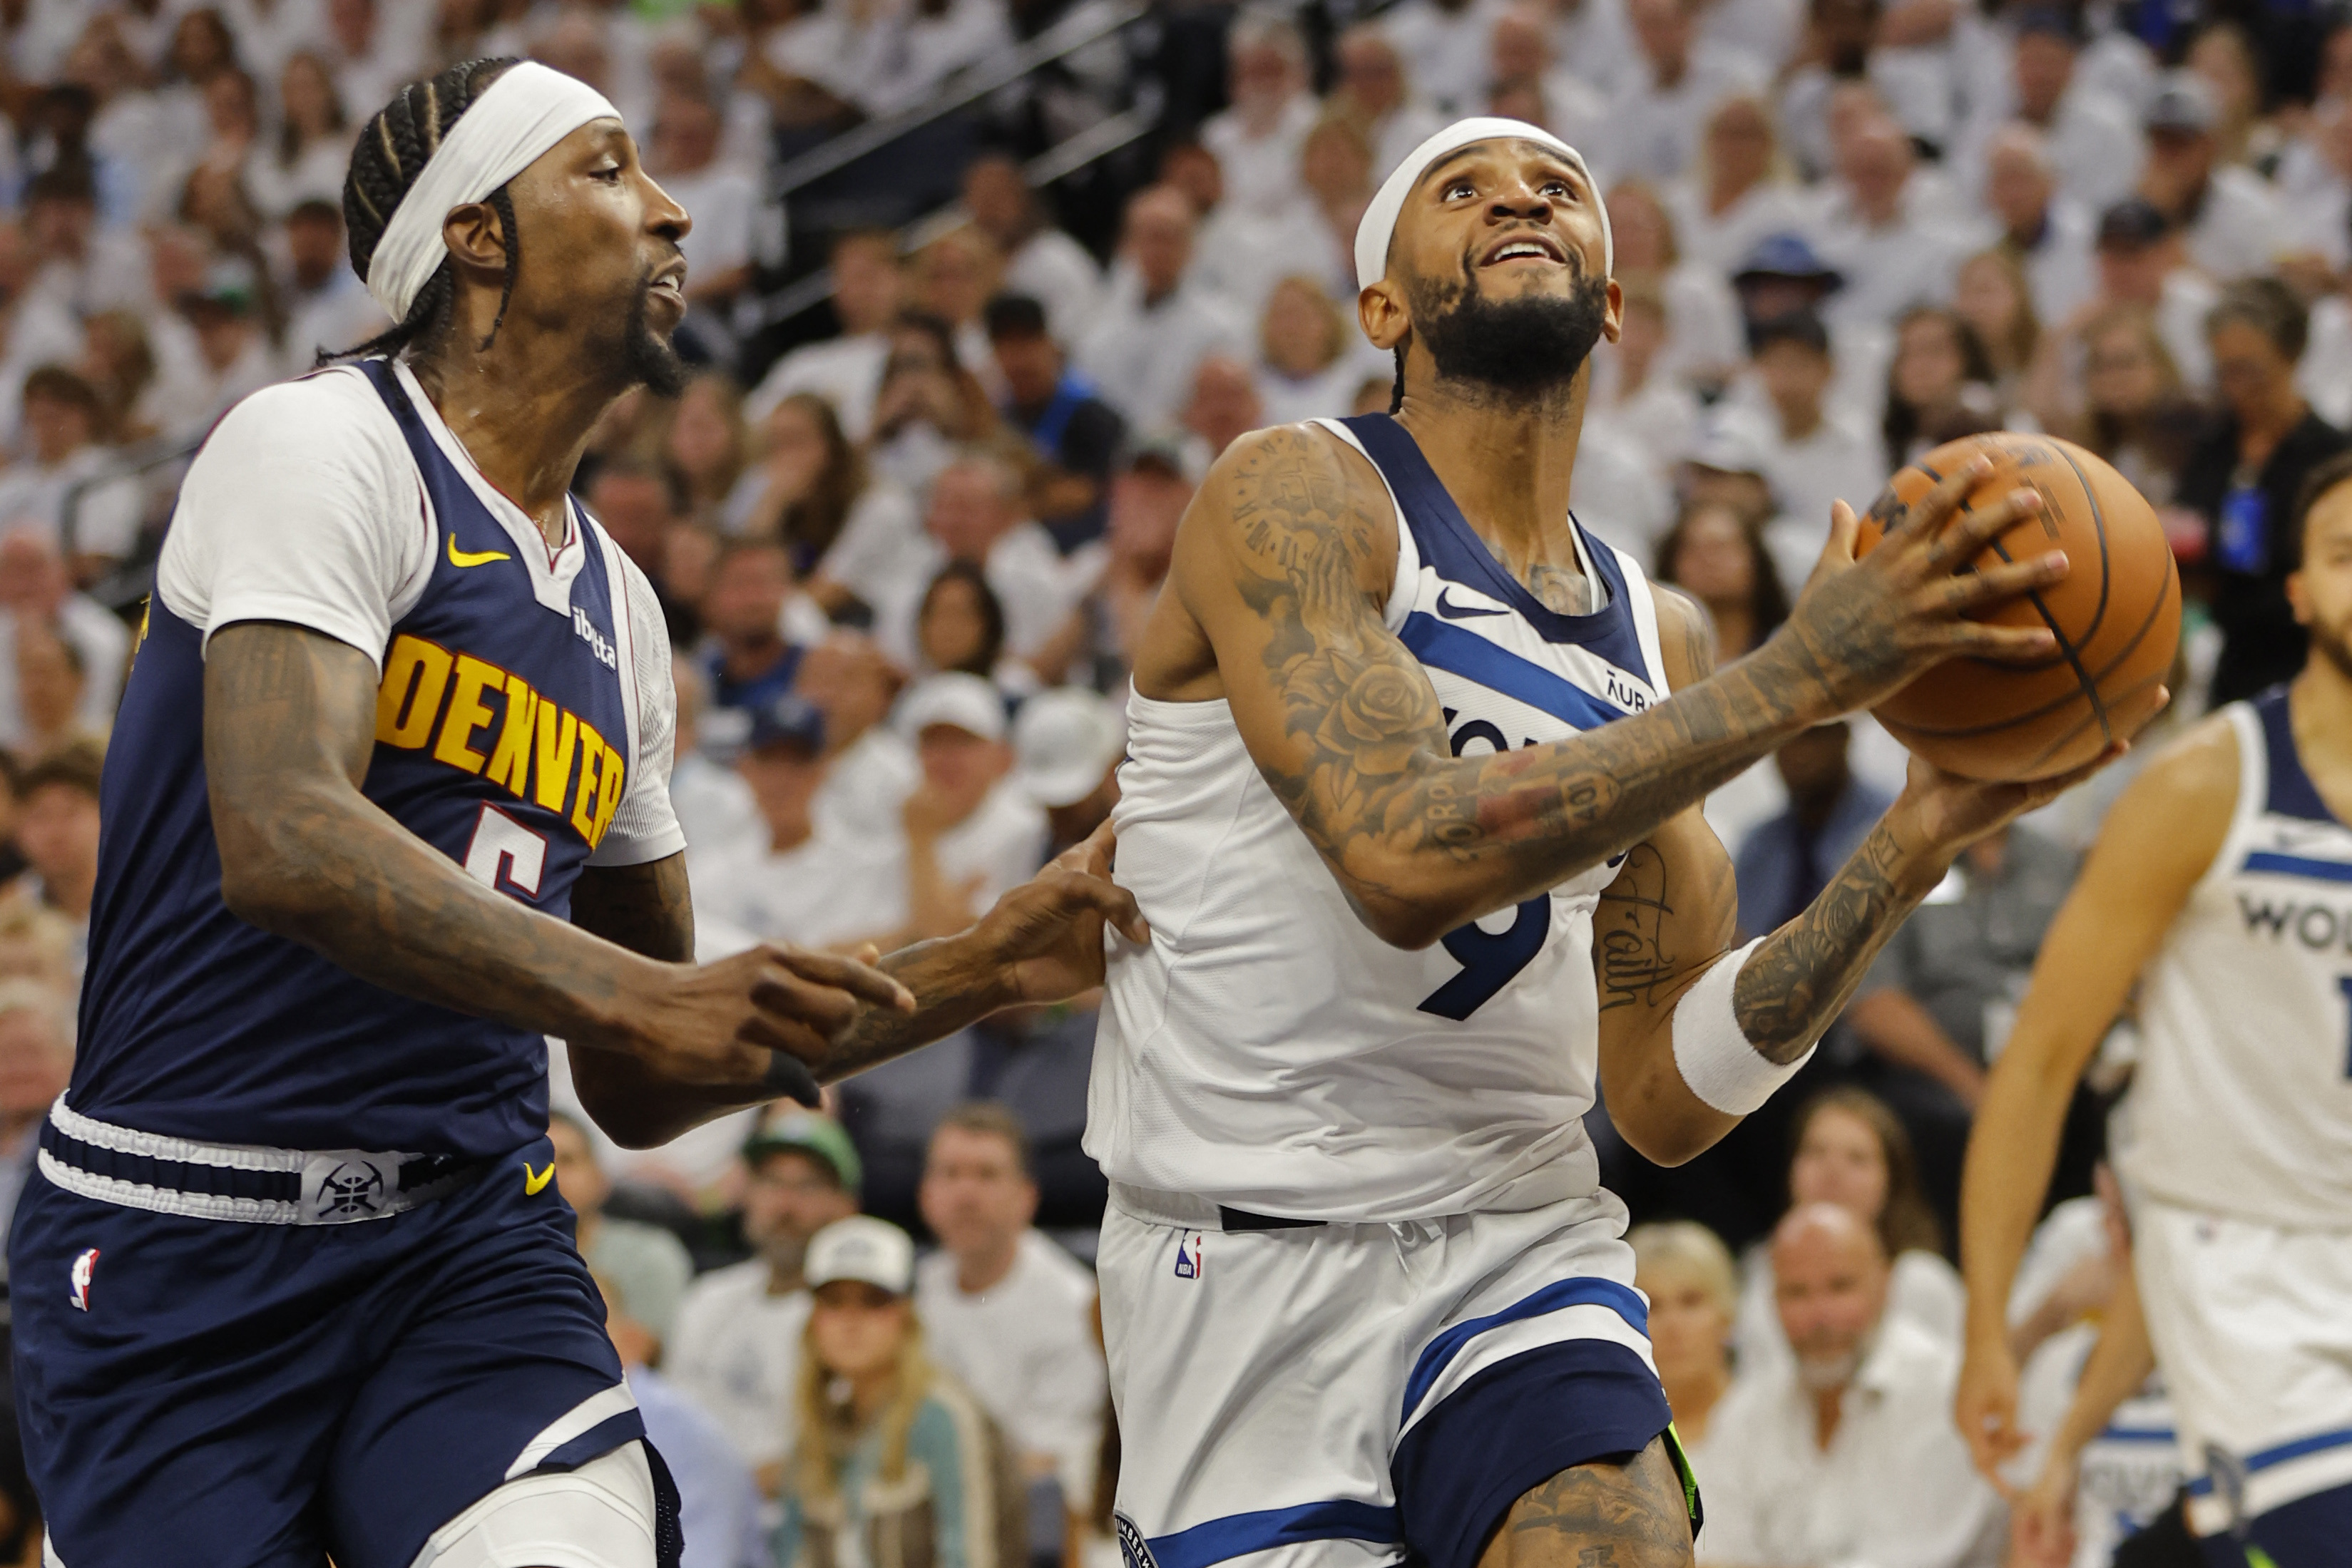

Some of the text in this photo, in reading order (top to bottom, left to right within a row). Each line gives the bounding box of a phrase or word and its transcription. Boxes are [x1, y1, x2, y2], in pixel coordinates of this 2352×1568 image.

[375, 633, 625, 851] DENVER
[2236, 892, 2352, 955] WO
[1177, 1263, 1192, 1276] NBA
